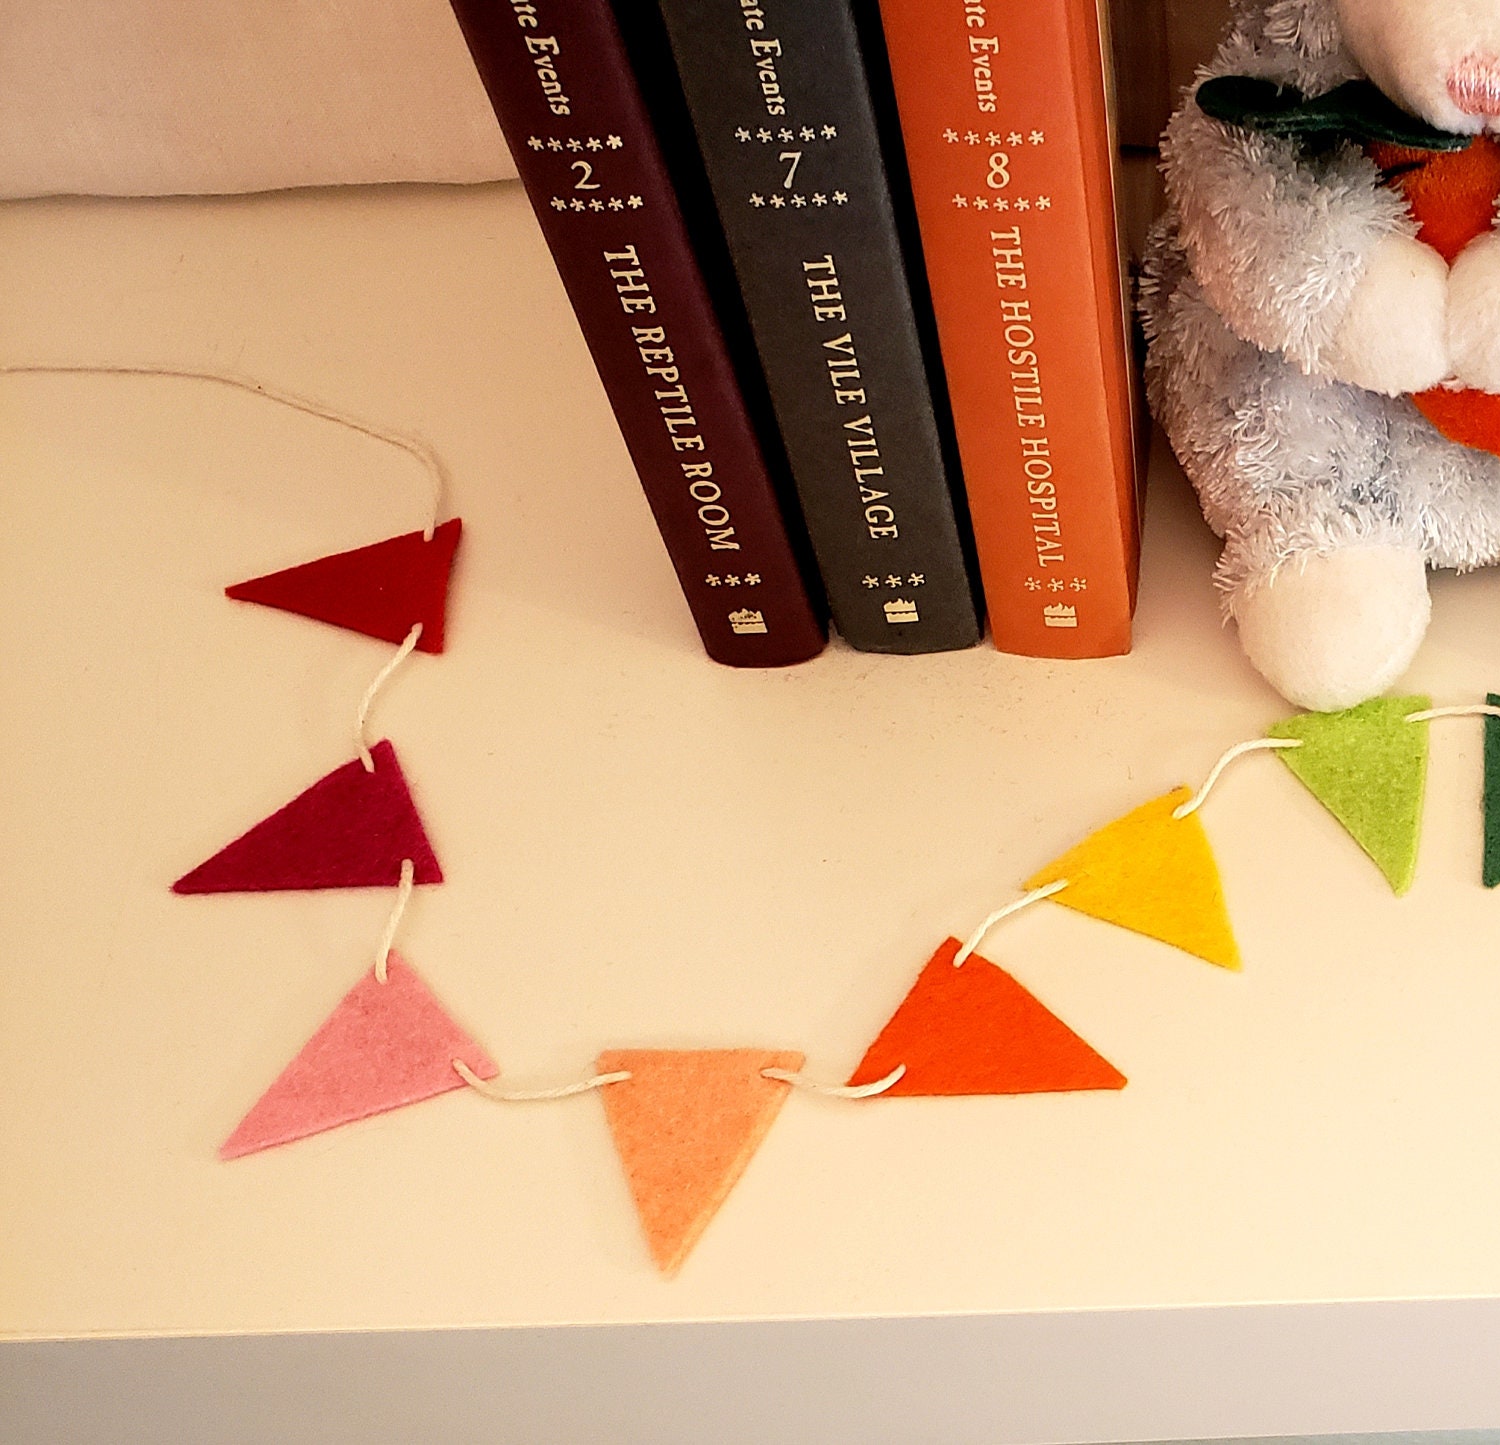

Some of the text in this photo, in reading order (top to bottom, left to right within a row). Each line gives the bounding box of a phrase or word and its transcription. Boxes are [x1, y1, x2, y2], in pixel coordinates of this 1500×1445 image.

[524, 35, 571, 115] Events
[750, 38, 786, 116] Events
[968, 35, 999, 113] Events
[570, 160, 601, 190] 2
[779, 151, 802, 189] 7
[986, 152, 1010, 189] 8
[603, 244, 740, 550] THE REPTILE ROOM
[802, 254, 899, 539] THE VILE VILLAGE
[990, 226, 1064, 568] THE HOSTILE HOSPITAL
